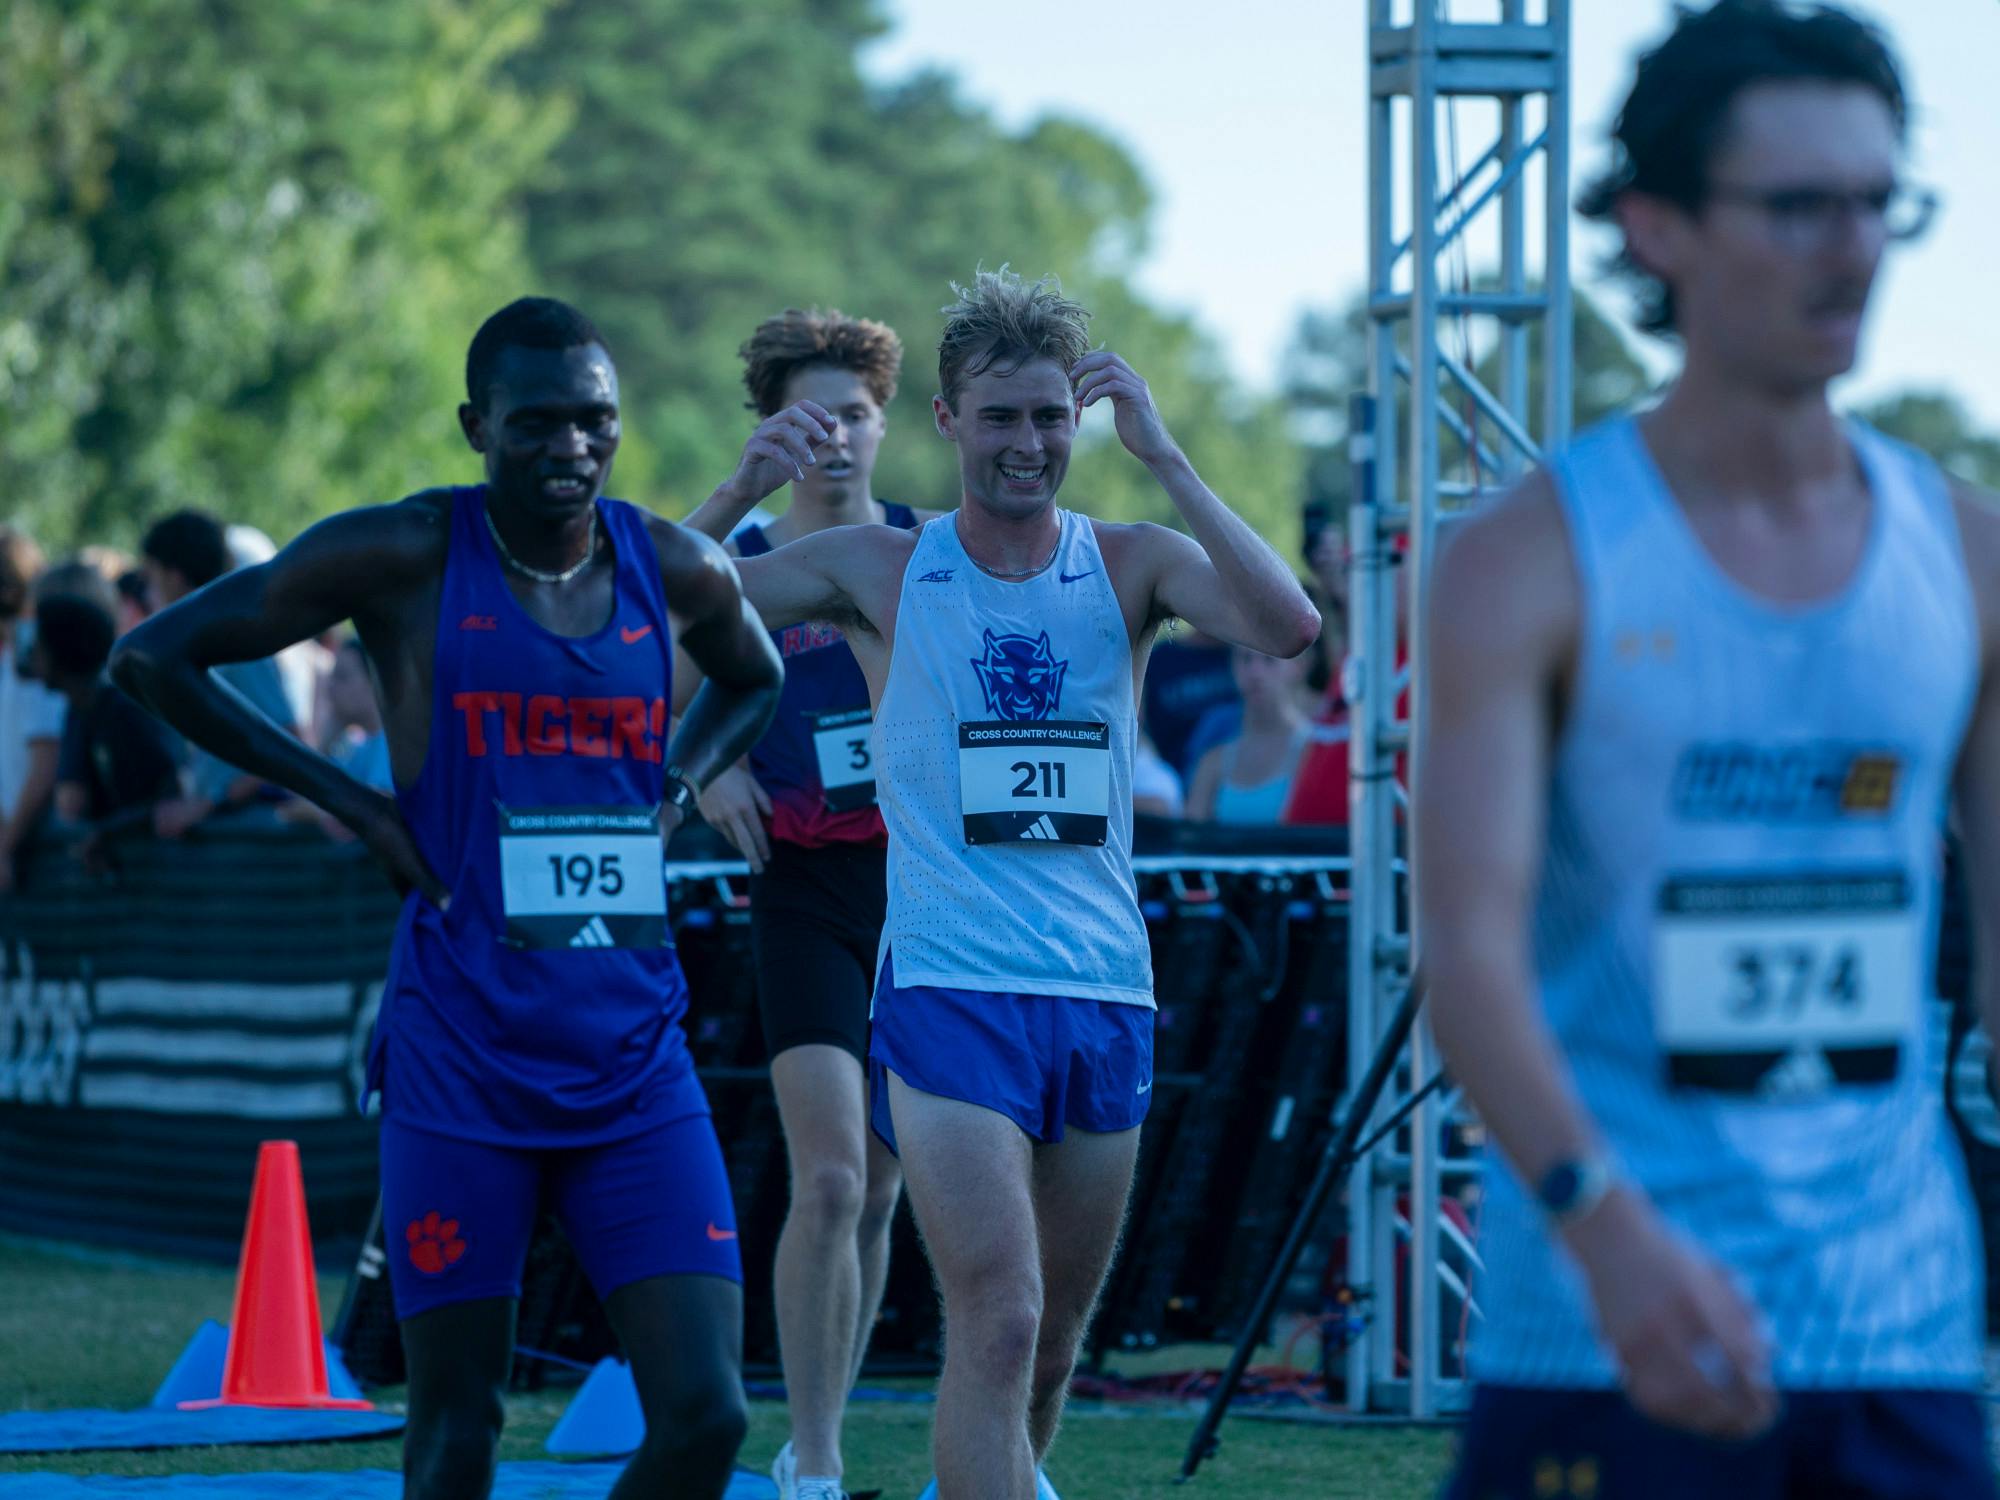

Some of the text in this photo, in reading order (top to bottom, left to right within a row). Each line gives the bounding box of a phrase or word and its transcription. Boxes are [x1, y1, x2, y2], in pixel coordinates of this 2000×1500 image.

[917, 569, 957, 582] ACC
[968, 729, 1102, 741] CROSS COUNTRY CHALLENGE
[1010, 761, 1066, 798] 211
[509, 815, 651, 829] CROSS COUNTRY CHALLENGE
[549, 855, 623, 897] 195
[1725, 944, 1863, 1020] 374
